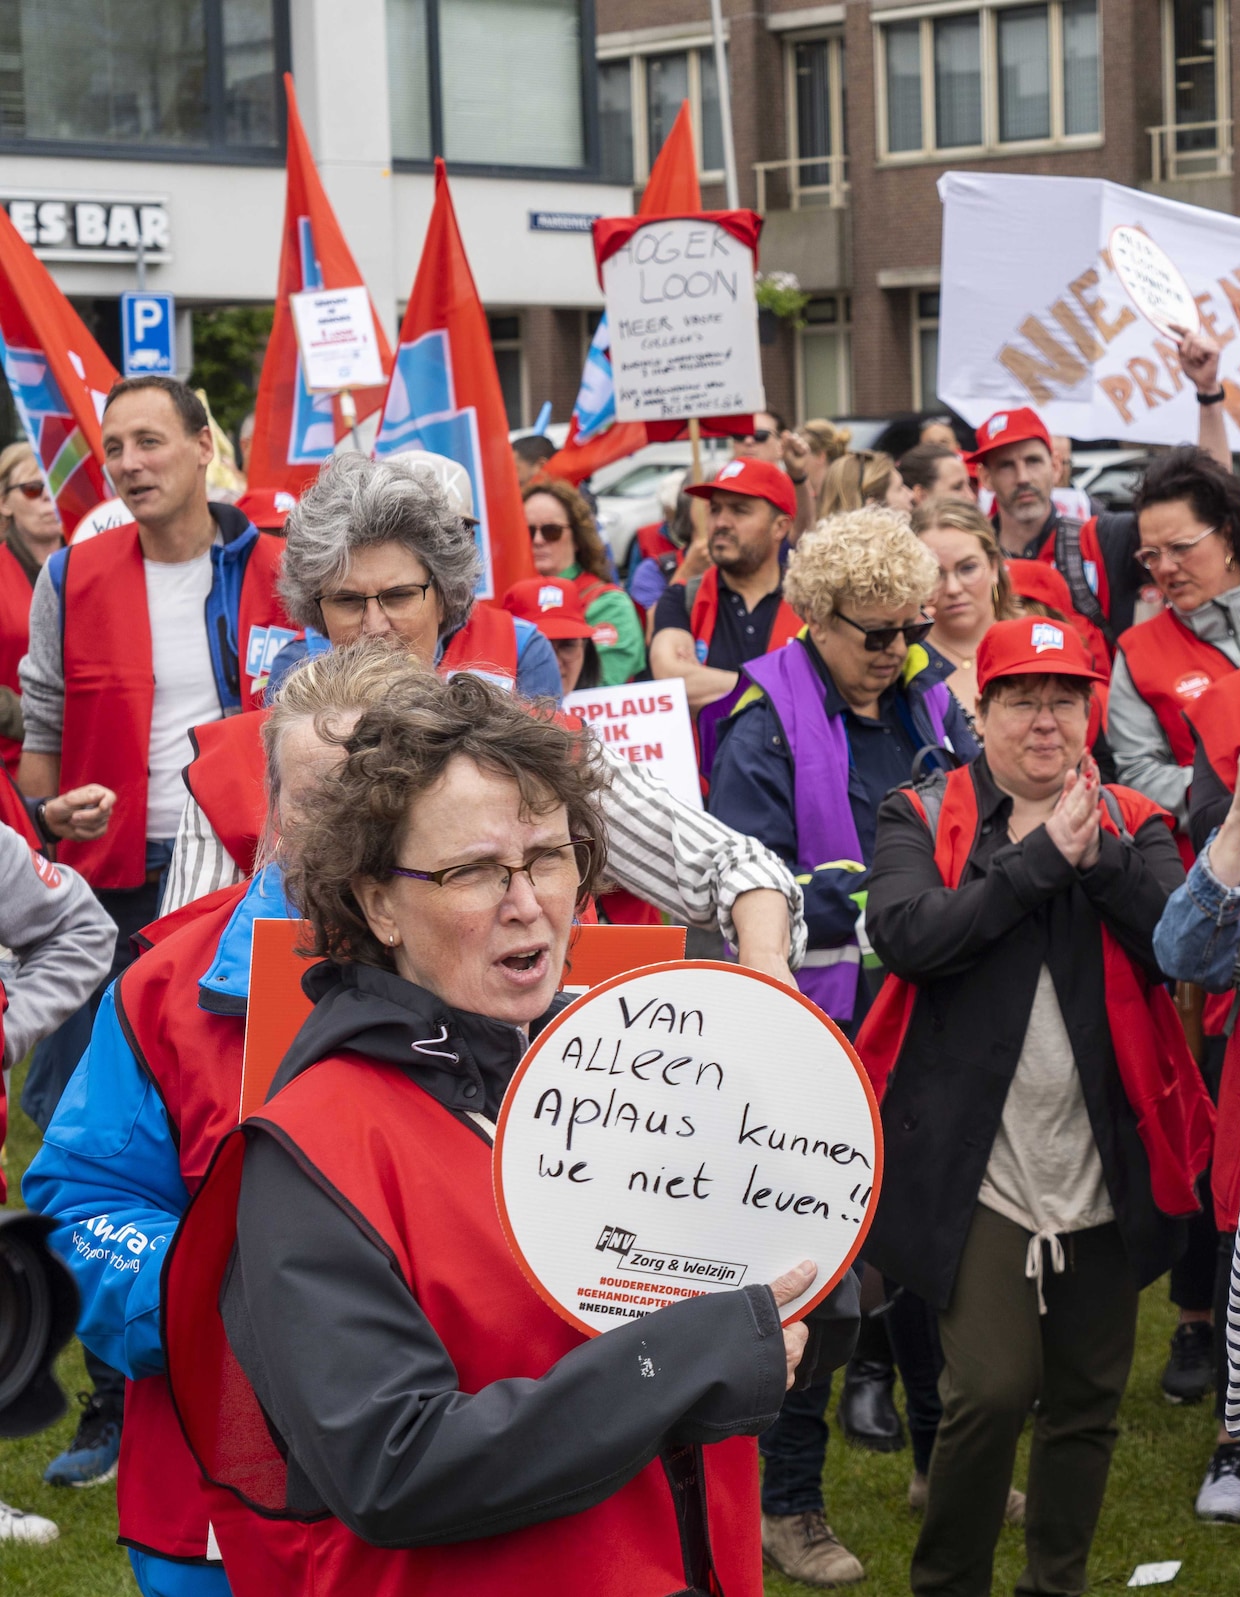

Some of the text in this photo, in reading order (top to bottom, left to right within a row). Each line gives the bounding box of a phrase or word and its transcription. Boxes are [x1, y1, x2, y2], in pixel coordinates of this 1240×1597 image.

[75, 203, 170, 249] BAR
[639, 268, 738, 304] LOON
[134, 299, 164, 343] P
[618, 315, 674, 341] MEER
[998, 247, 1138, 406] NIE
[1033, 627, 1064, 645] FNV
[566, 694, 674, 721] PPLAUS
[738, 1102, 873, 1170] kunnen
[628, 1162, 715, 1201] niet
[598, 1229, 637, 1251] FNV
[630, 1253, 736, 1281] Zorg & Welzijn
